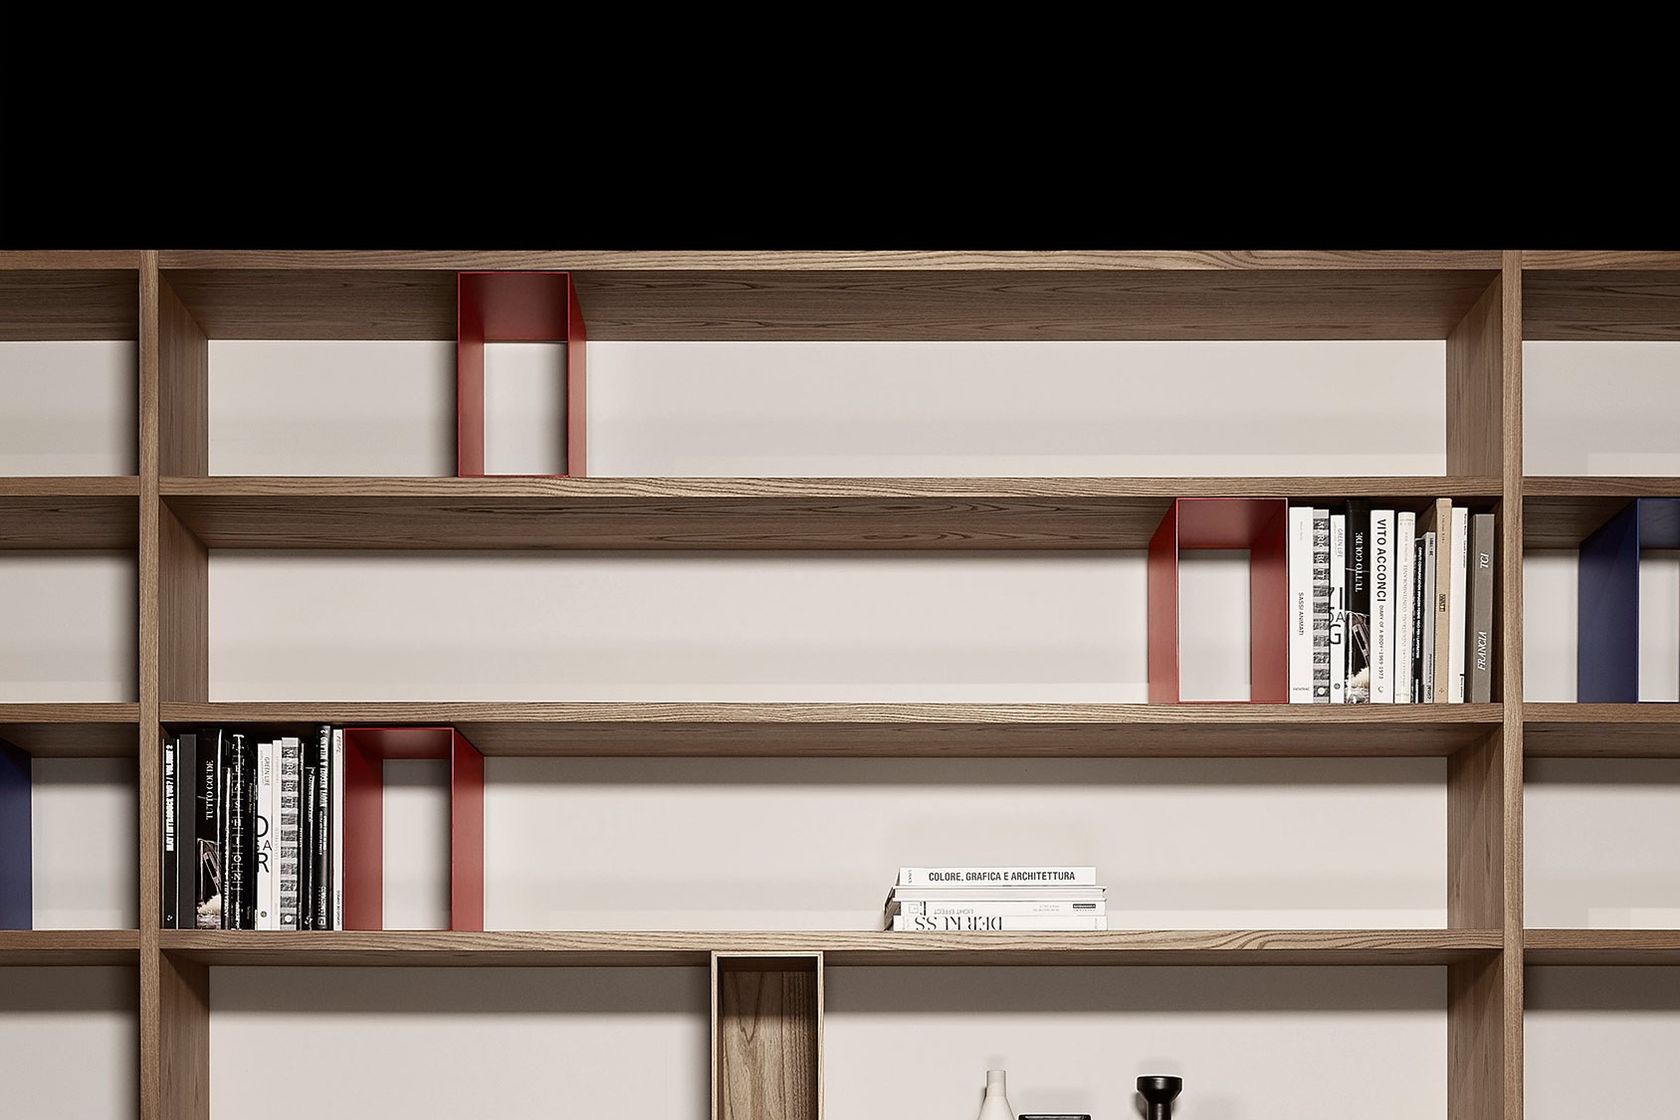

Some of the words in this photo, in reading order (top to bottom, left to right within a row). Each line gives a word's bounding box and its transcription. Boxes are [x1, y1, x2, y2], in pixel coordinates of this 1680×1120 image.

[1376, 519, 1387, 546] VITO
[1480, 552, 1490, 569] TCI
[1355, 563, 1364, 593] TUTTO
[1376, 547, 1387, 602] ACCONCI
[1477, 631, 1487, 671] FRANCIA
[320, 736, 329, 760] MILANO
[165, 750, 174, 776] VOLUME
[205, 791, 214, 821] TUTTO
[165, 836, 175, 852] MAY
[965, 871, 1002, 882] GRAFICA
[1003, 871, 1009, 881] E
[1010, 871, 1076, 881] ARCHITETTURA
[914, 916, 961, 931] KUSS
[967, 916, 1003, 931] DER
